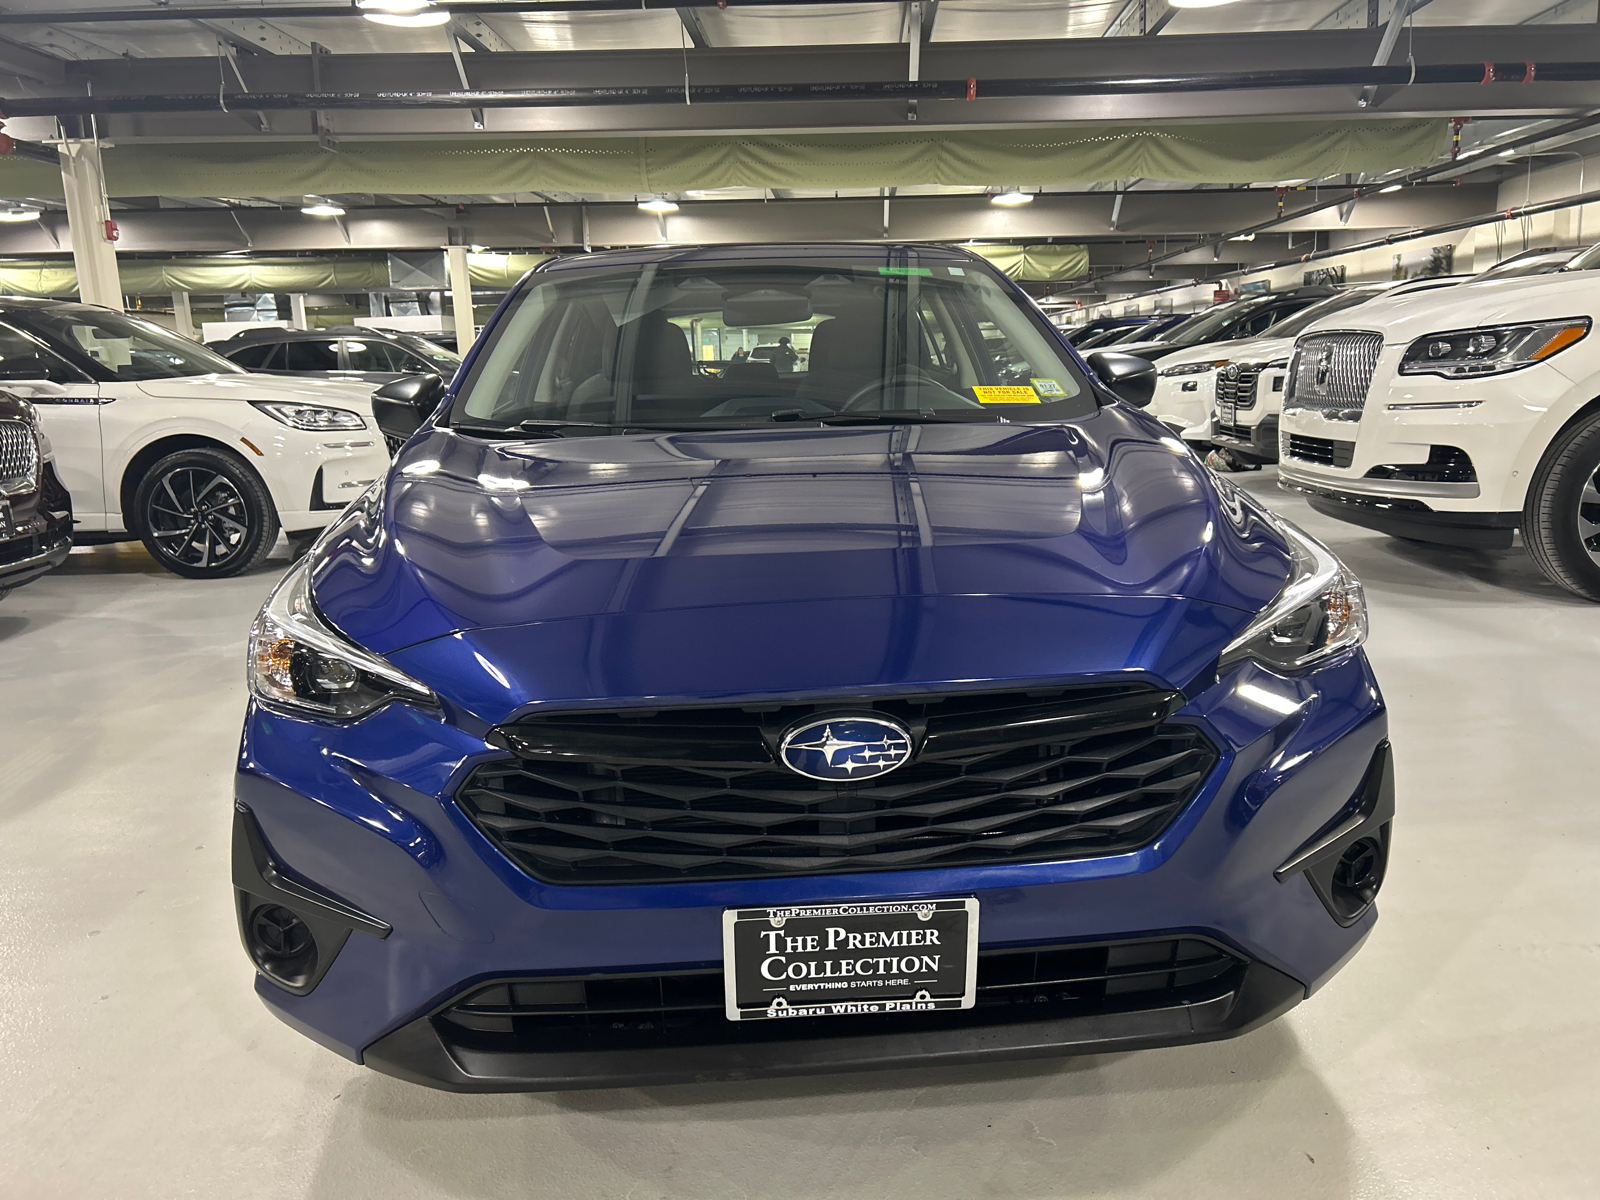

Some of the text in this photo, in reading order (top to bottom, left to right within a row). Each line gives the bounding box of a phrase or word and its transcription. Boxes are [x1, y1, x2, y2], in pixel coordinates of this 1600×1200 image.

[760, 927, 942, 955] THE PREMIER
[760, 955, 941, 981] COLLECTION
[790, 982, 848, 991] EVERYTHING
[850, 980, 883, 988] STARTS
[767, 1001, 936, 1018] Subaru White Plains
